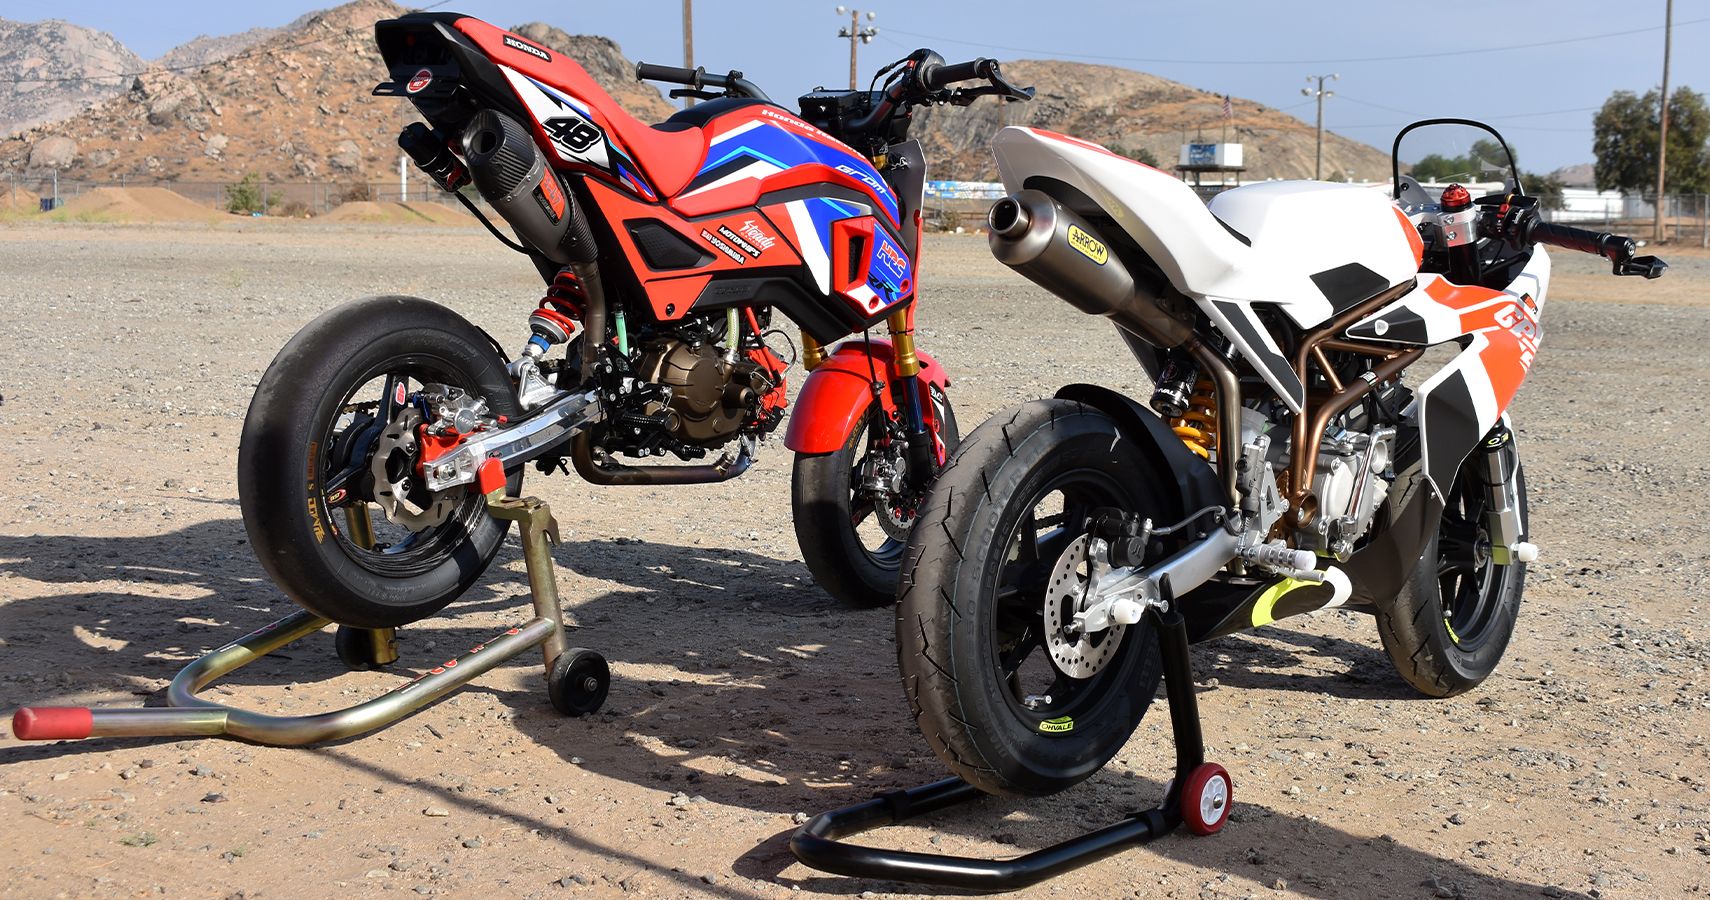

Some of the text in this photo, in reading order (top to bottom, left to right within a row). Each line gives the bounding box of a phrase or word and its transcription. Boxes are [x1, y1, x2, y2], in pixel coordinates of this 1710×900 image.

[505, 37, 550, 60] HONDA
[541, 116, 602, 153] 48
[762, 109, 815, 132] Honda
[739, 220, 775, 251] Steady
[1072, 229, 1105, 257] ARROW
[877, 239, 907, 279] HRC
[1041, 722, 1073, 731] OHVALE
